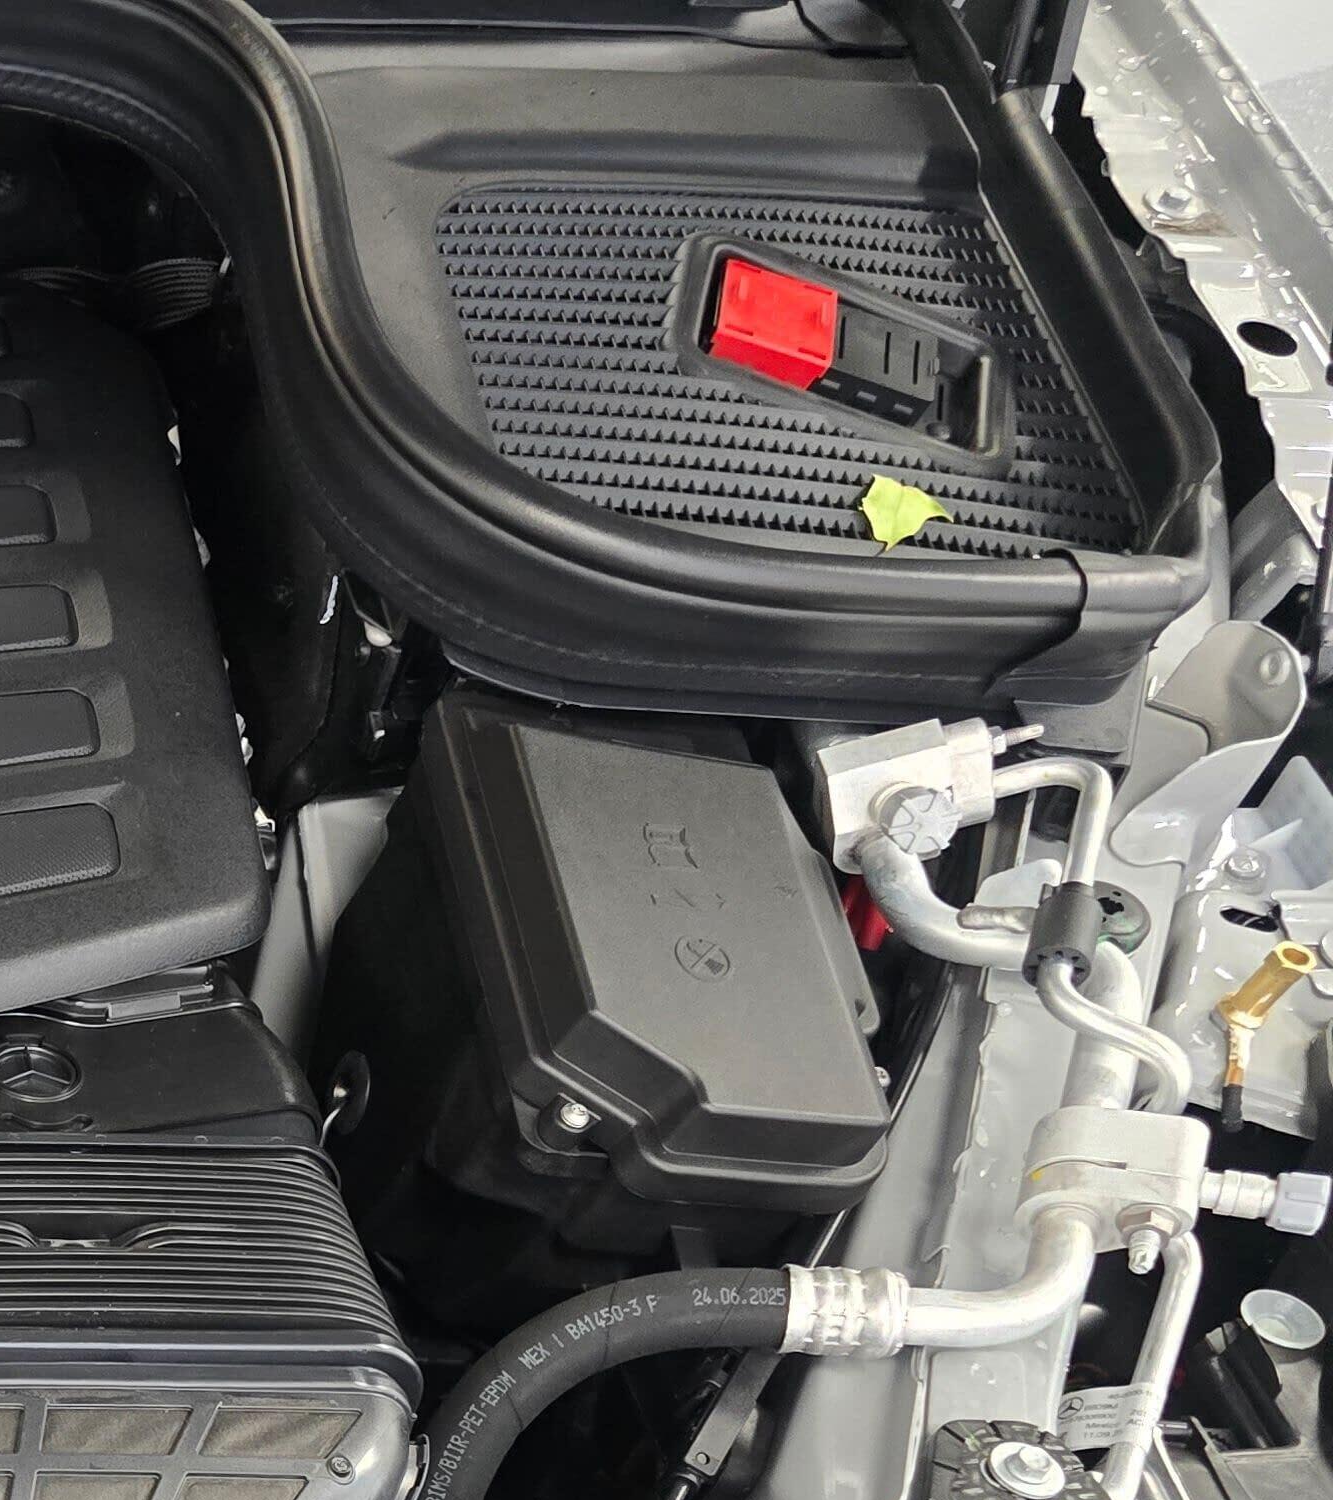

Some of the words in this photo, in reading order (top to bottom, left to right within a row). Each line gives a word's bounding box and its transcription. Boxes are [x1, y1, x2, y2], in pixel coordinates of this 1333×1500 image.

[517, 1341, 551, 1370] MEX
[565, 1298, 642, 1341] BA1450-3
[645, 1294, 658, 1313] F
[692, 1287, 787, 1307] 24.06.2025
